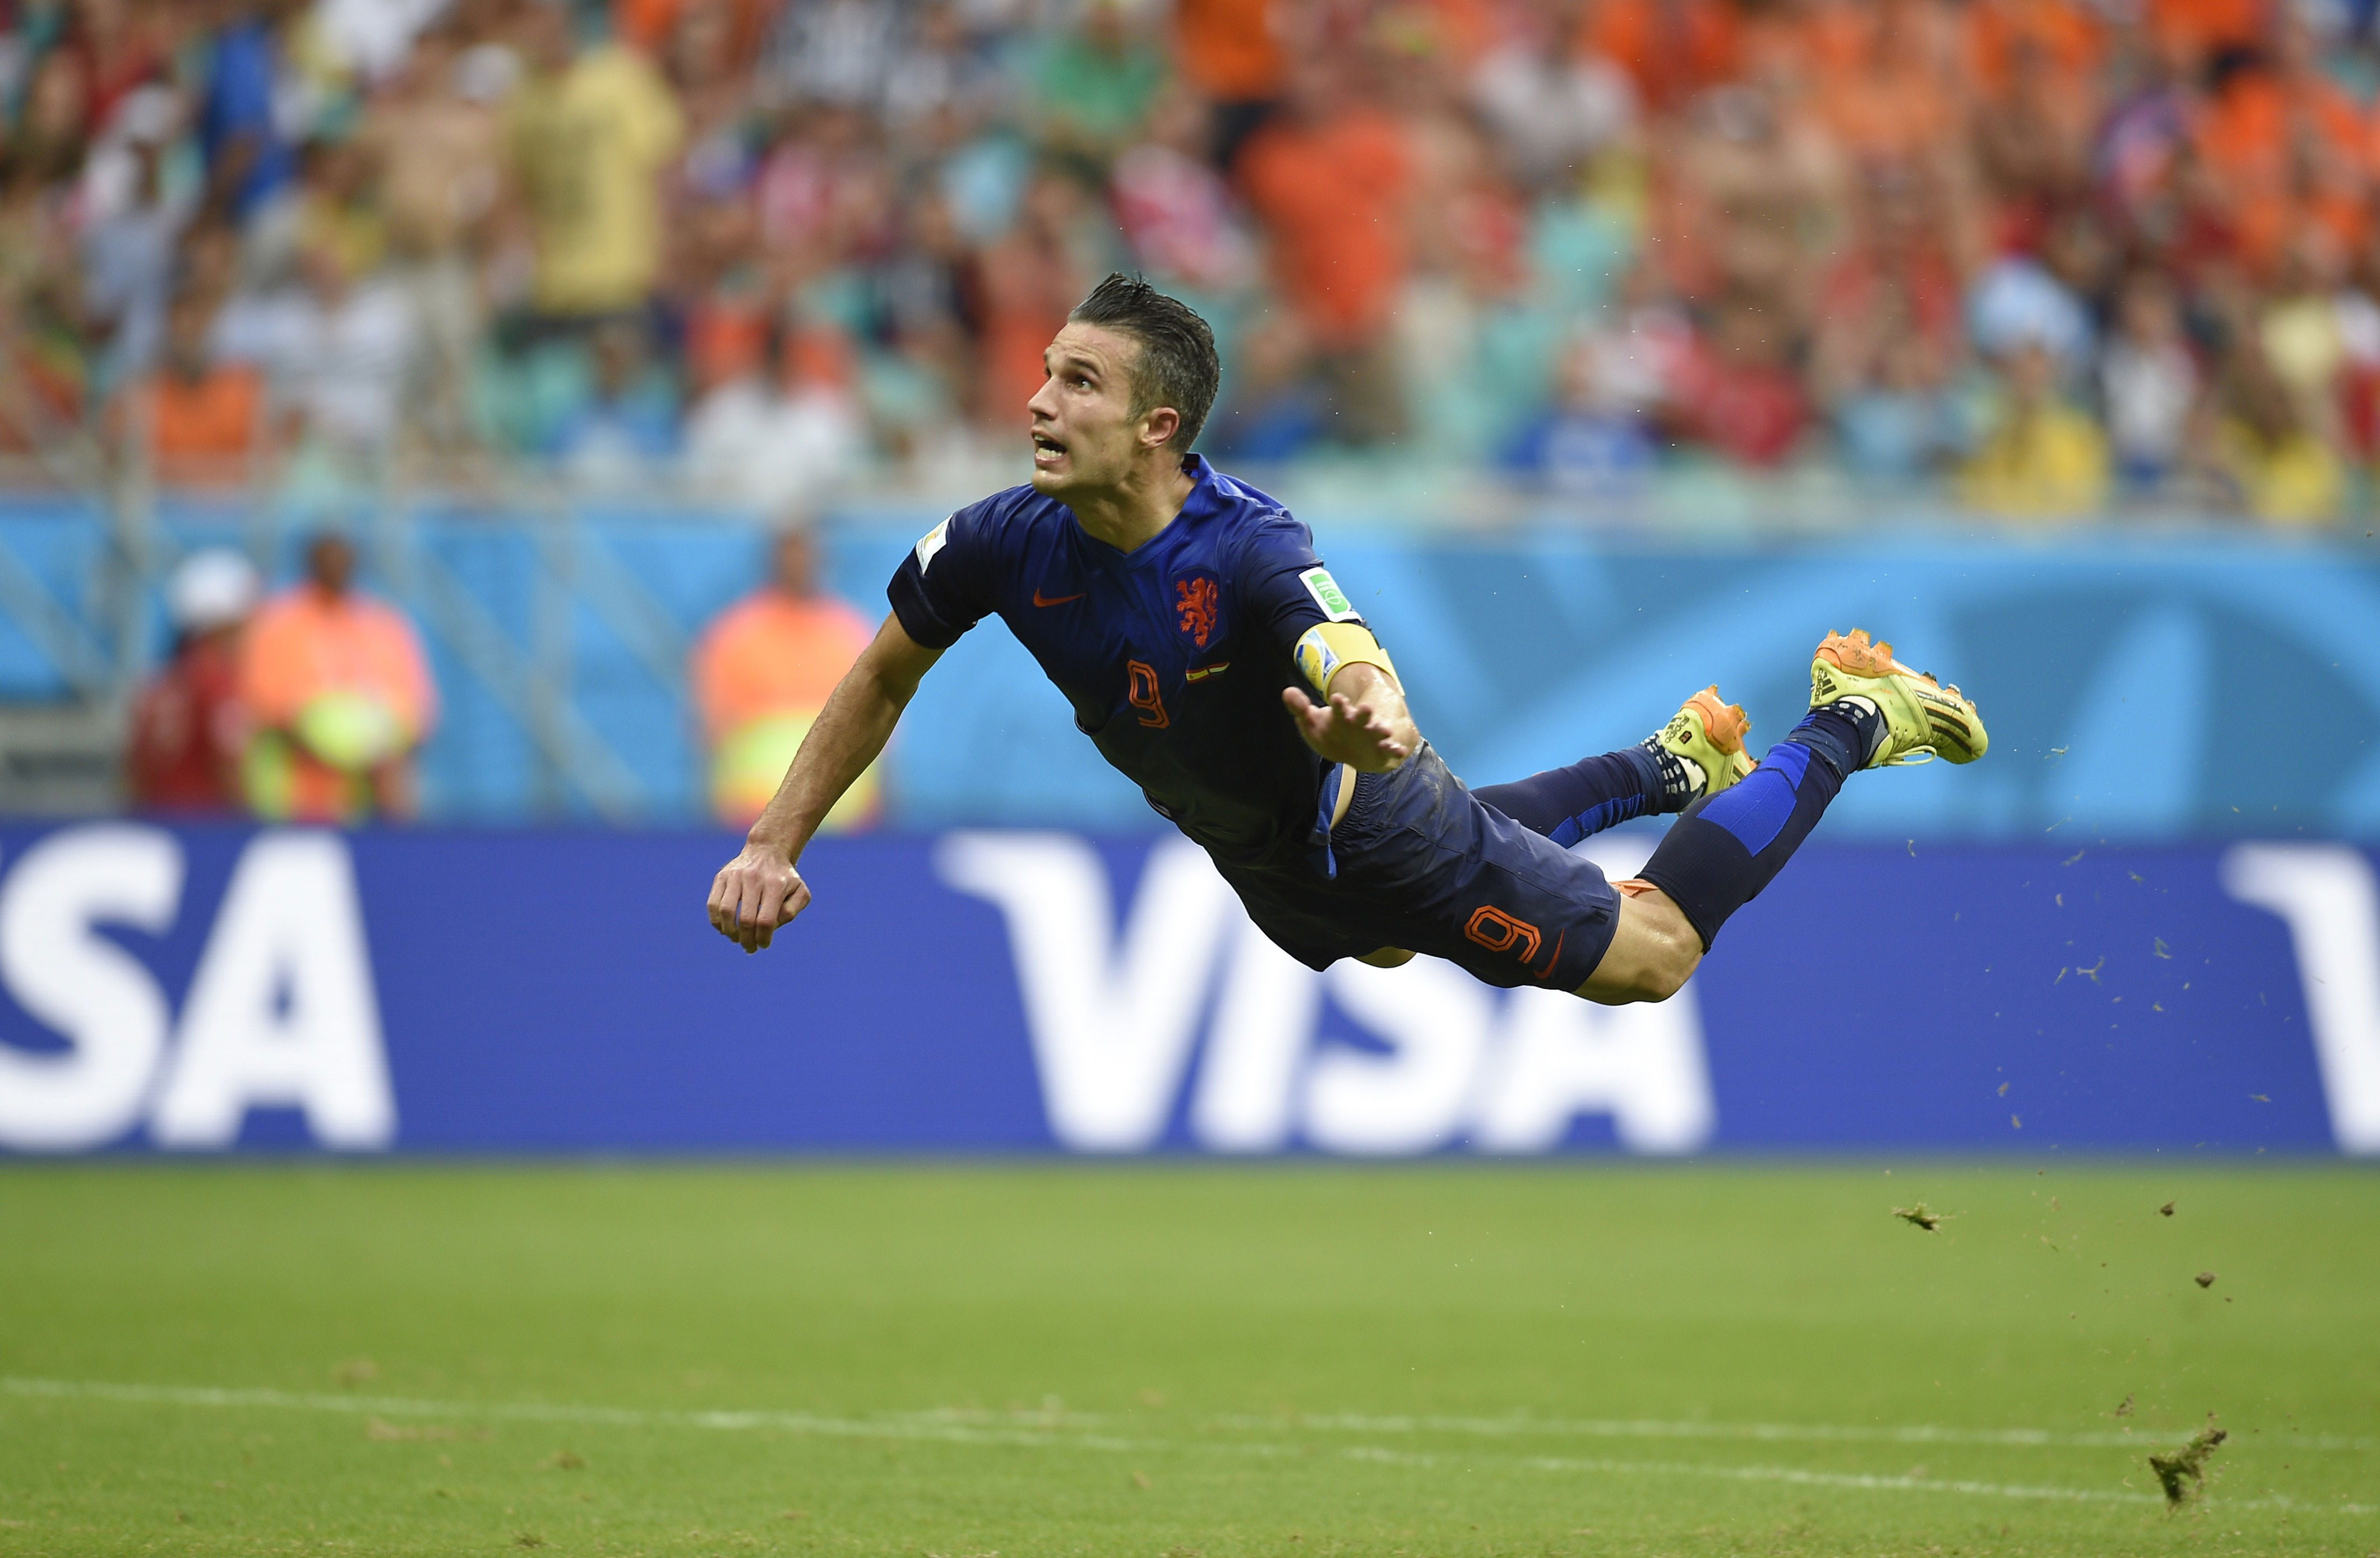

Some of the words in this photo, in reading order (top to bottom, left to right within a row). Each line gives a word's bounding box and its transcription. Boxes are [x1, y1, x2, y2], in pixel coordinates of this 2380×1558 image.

[1127, 659, 1170, 729] 9
[1814, 668, 1824, 702] adidas
[1664, 715, 1690, 744] adidas
[1464, 904, 1542, 964] 9
